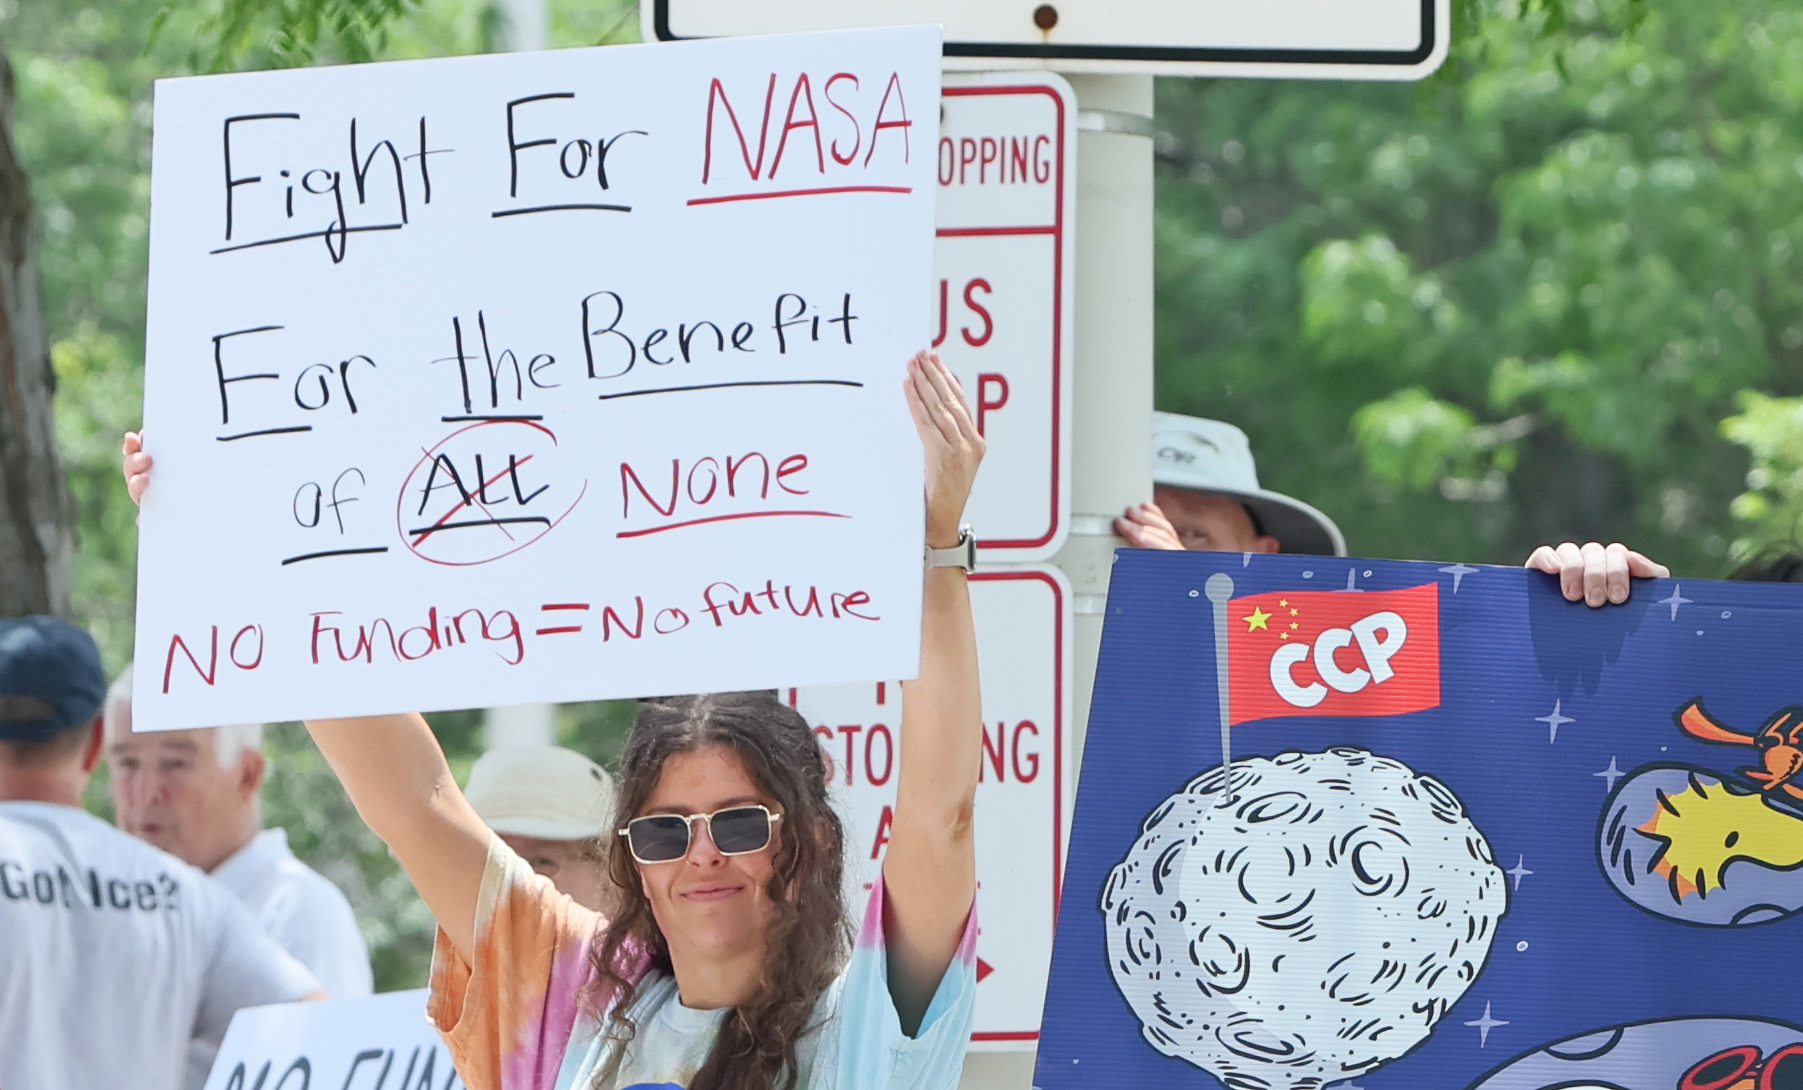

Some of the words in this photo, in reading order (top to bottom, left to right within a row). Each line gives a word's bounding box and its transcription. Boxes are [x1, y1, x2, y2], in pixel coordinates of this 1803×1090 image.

[222, 110, 454, 263] Fight
[507, 92, 648, 198] For
[703, 71, 912, 186] NASA
[938, 134, 1051, 186] OPPING
[212, 325, 377, 425] For
[430, 310, 562, 417] the
[581, 290, 861, 380] Benefit
[292, 468, 366, 536] of
[619, 450, 812, 518] None
[1268, 610, 1409, 708] CCP
[811, 719, 1041, 788] STONG
